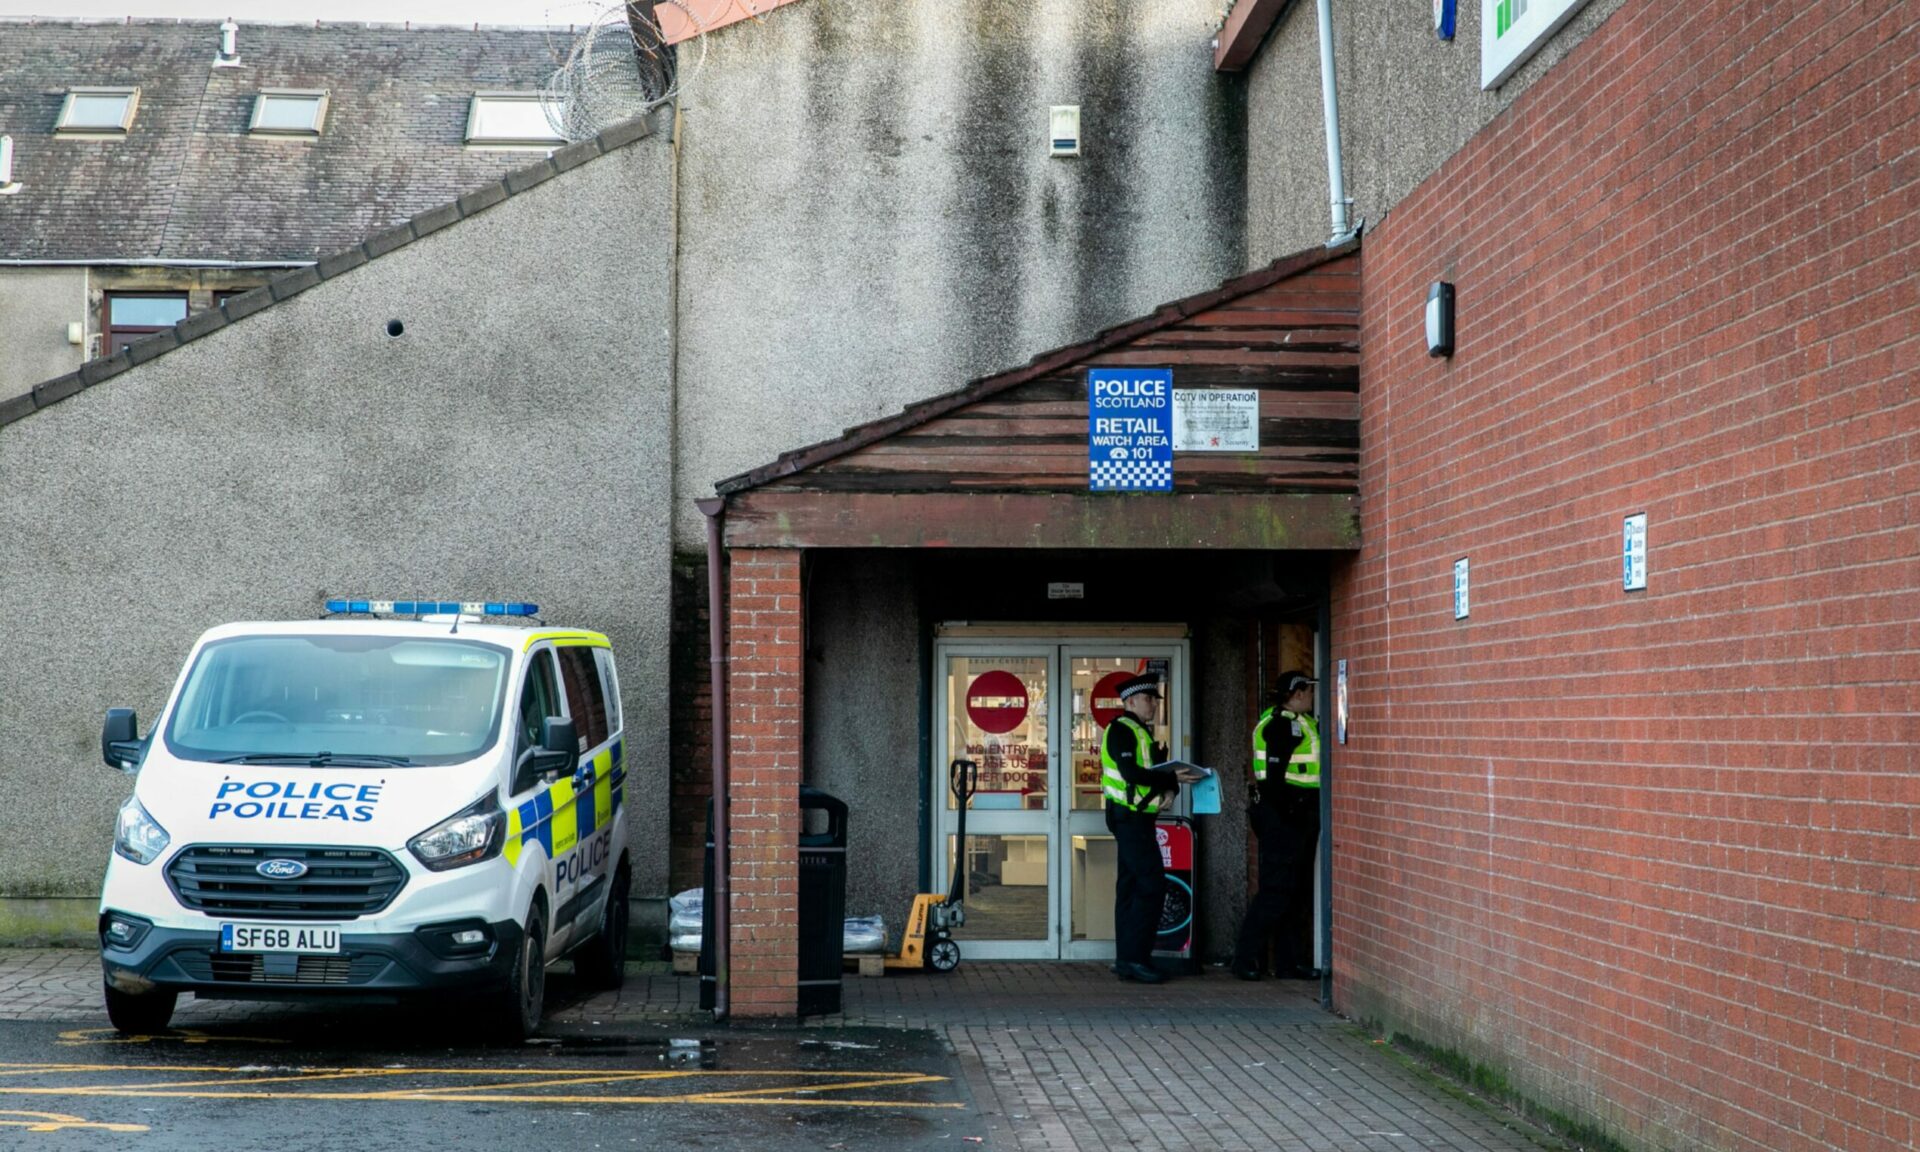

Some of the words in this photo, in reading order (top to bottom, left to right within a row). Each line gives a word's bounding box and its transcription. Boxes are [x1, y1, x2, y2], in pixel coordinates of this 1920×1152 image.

[1094, 380, 1165, 396] POLICE
[1095, 397, 1166, 409] SCOTLAND
[1174, 393, 1197, 402] CCTV
[1198, 393, 1207, 402] IN
[1208, 392, 1257, 402] OPERATION
[1096, 418, 1164, 434] RETAIL
[1092, 436, 1132, 446] WATCH
[1136, 436, 1168, 446] AREA
[1132, 447, 1152, 459] 101
[966, 744, 984, 755] NO
[989, 744, 1029, 755] ENTRY
[215, 781, 383, 803] POLICE
[209, 802, 375, 822] POILEAS
[556, 829, 611, 894] POLICE
[799, 856, 828, 865] ITTER
[266, 861, 296, 875] Ford
[236, 928, 290, 948] SF68
[296, 930, 336, 949] ALU
